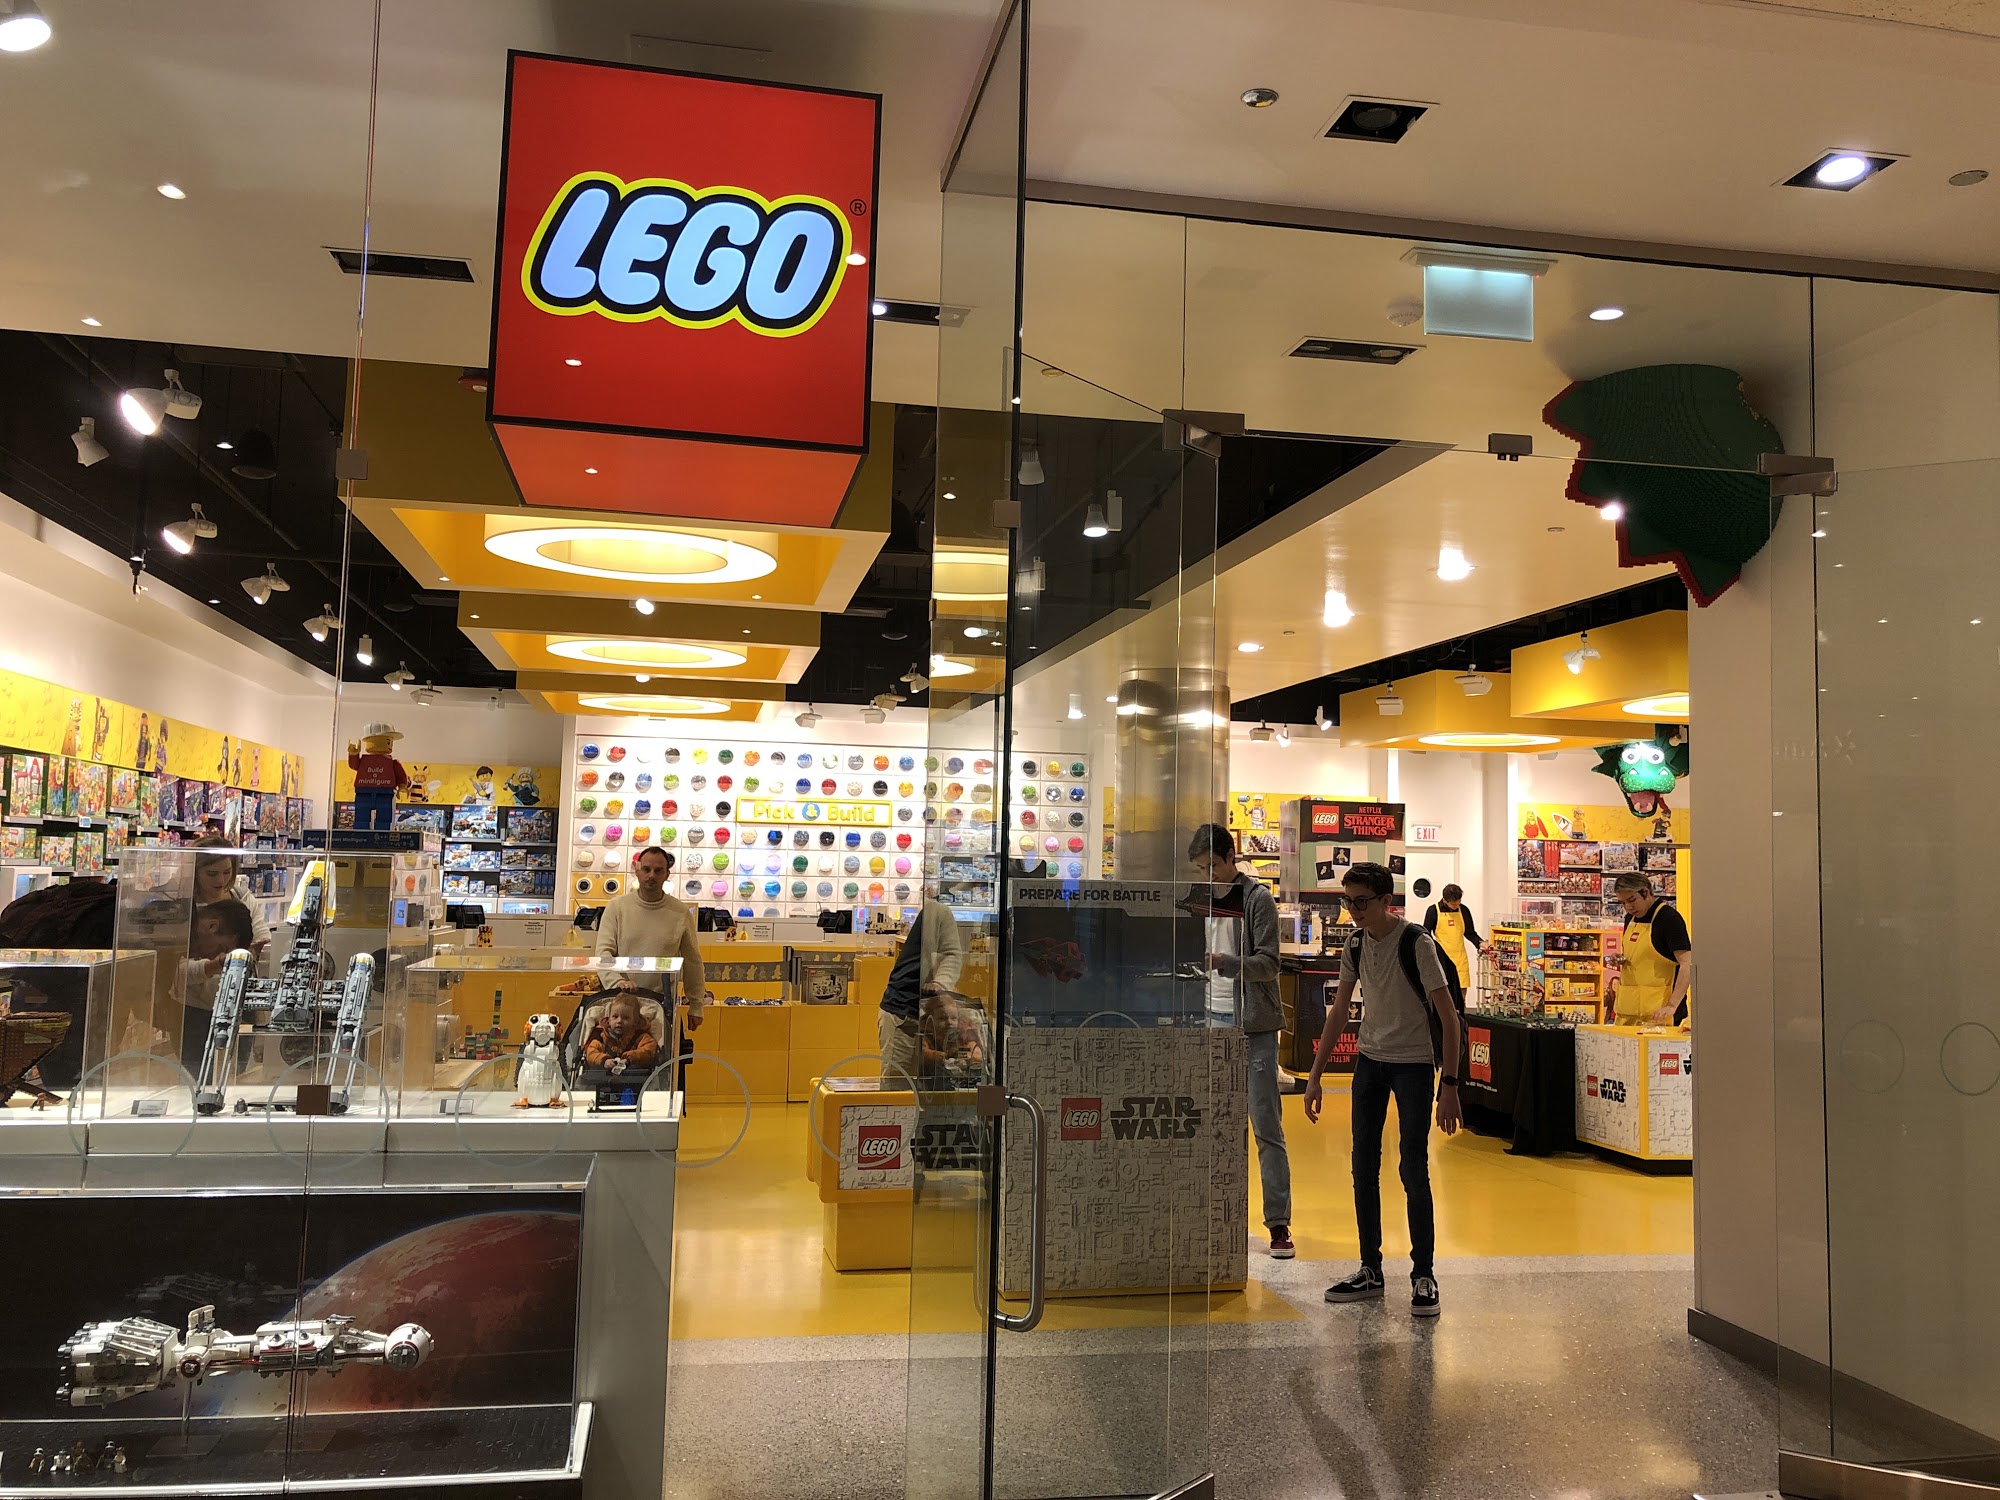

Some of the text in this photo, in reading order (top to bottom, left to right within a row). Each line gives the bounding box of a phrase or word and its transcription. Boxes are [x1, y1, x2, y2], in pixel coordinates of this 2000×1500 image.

[528, 177, 845, 331] LEGO
[753, 801, 795, 820] Pick
[827, 803, 875, 822] Build
[1358, 806, 1382, 814] NETFLIX
[1313, 812, 1338, 825] LEGO
[1343, 814, 1396, 830] STRANGER
[1352, 826, 1388, 836] THINGS
[1416, 827, 1436, 840] EXIT
[1019, 888, 1161, 902] PREPARE FOR BATTLE
[1471, 1042, 1490, 1067] LEGO
[1660, 1060, 1678, 1069] LEGO
[1600, 1078, 1627, 1093] STAR
[1600, 1088, 1627, 1103] WARS
[1110, 1096, 1202, 1118] STAR
[1063, 1110, 1100, 1128] LEGO
[910, 1124, 978, 1147] STA
[1110, 1118, 1202, 1140] WARS
[860, 1138, 899, 1157] LEGO
